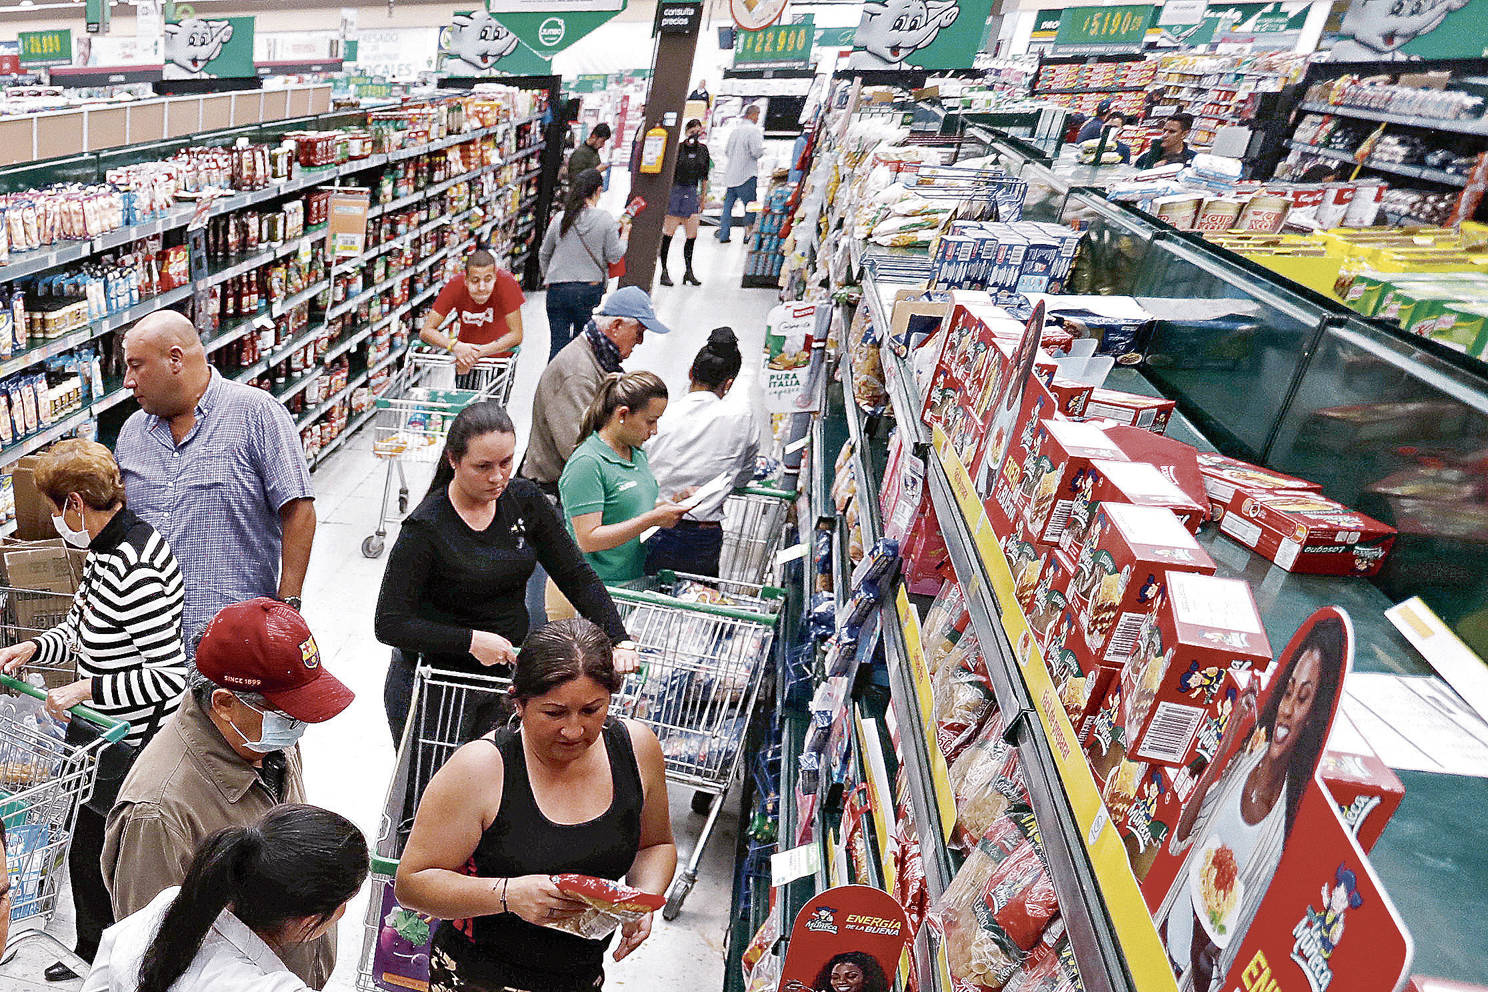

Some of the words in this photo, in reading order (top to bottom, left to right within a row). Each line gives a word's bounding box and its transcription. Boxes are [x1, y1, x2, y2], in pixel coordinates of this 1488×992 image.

[663, 8, 695, 18] consulta
[661, 17, 689, 27] precios
[769, 374, 798, 382] PURA
[769, 380, 801, 389] ITALIA
[223, 674, 247, 684] SINCE
[247, 678, 263, 688] 1899
[845, 914, 902, 931] ENERGÍA
[845, 924, 856, 932] DE
[863, 924, 901, 937] BUENA
